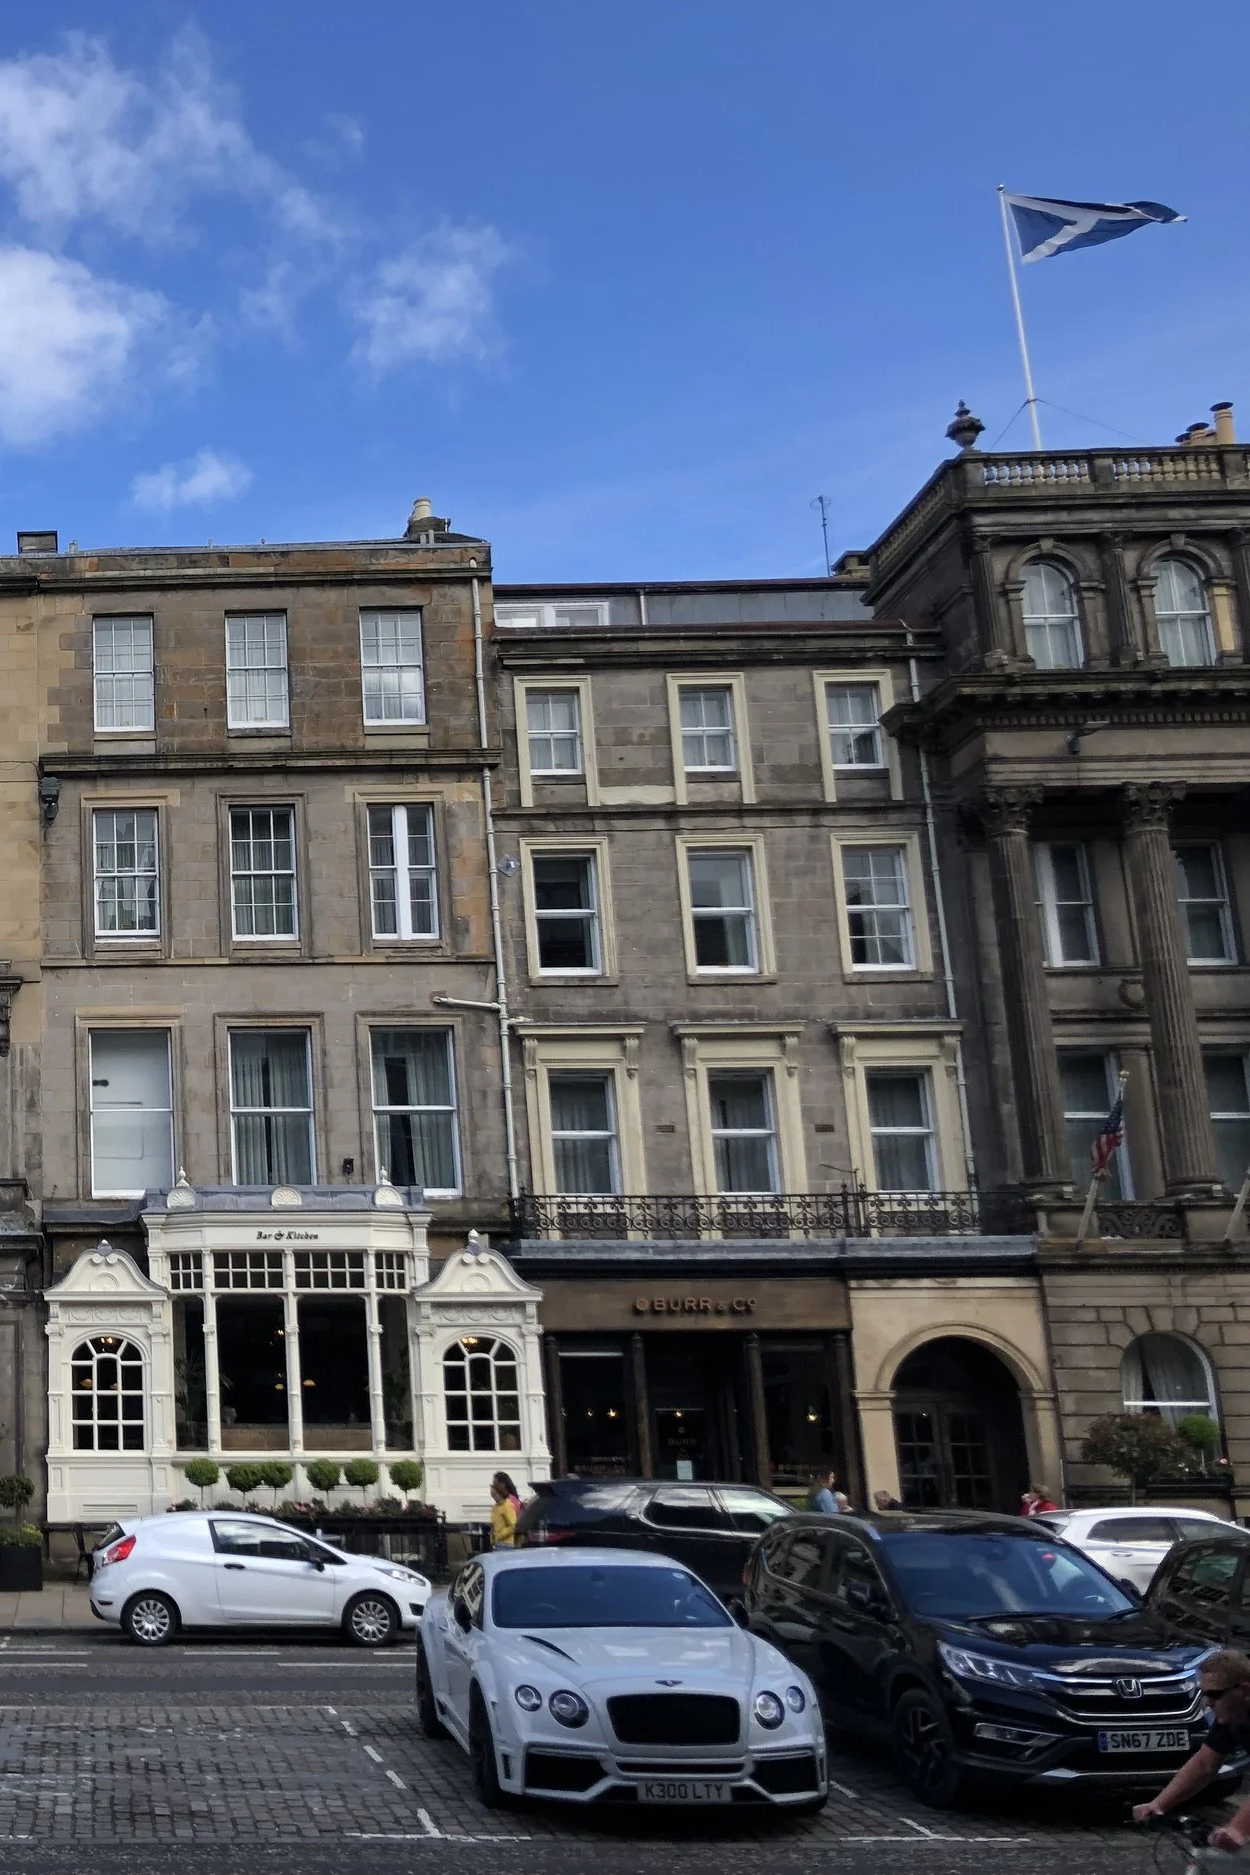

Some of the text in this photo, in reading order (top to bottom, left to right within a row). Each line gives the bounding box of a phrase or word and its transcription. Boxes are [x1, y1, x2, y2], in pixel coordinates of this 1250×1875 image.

[256, 1230, 319, 1241] Bar & Kitchen
[653, 1297, 712, 1311] BURR
[717, 1301, 727, 1310] &
[1110, 1731, 1186, 1749] SN67 ZDE
[692, 1783, 723, 1799] LTY
